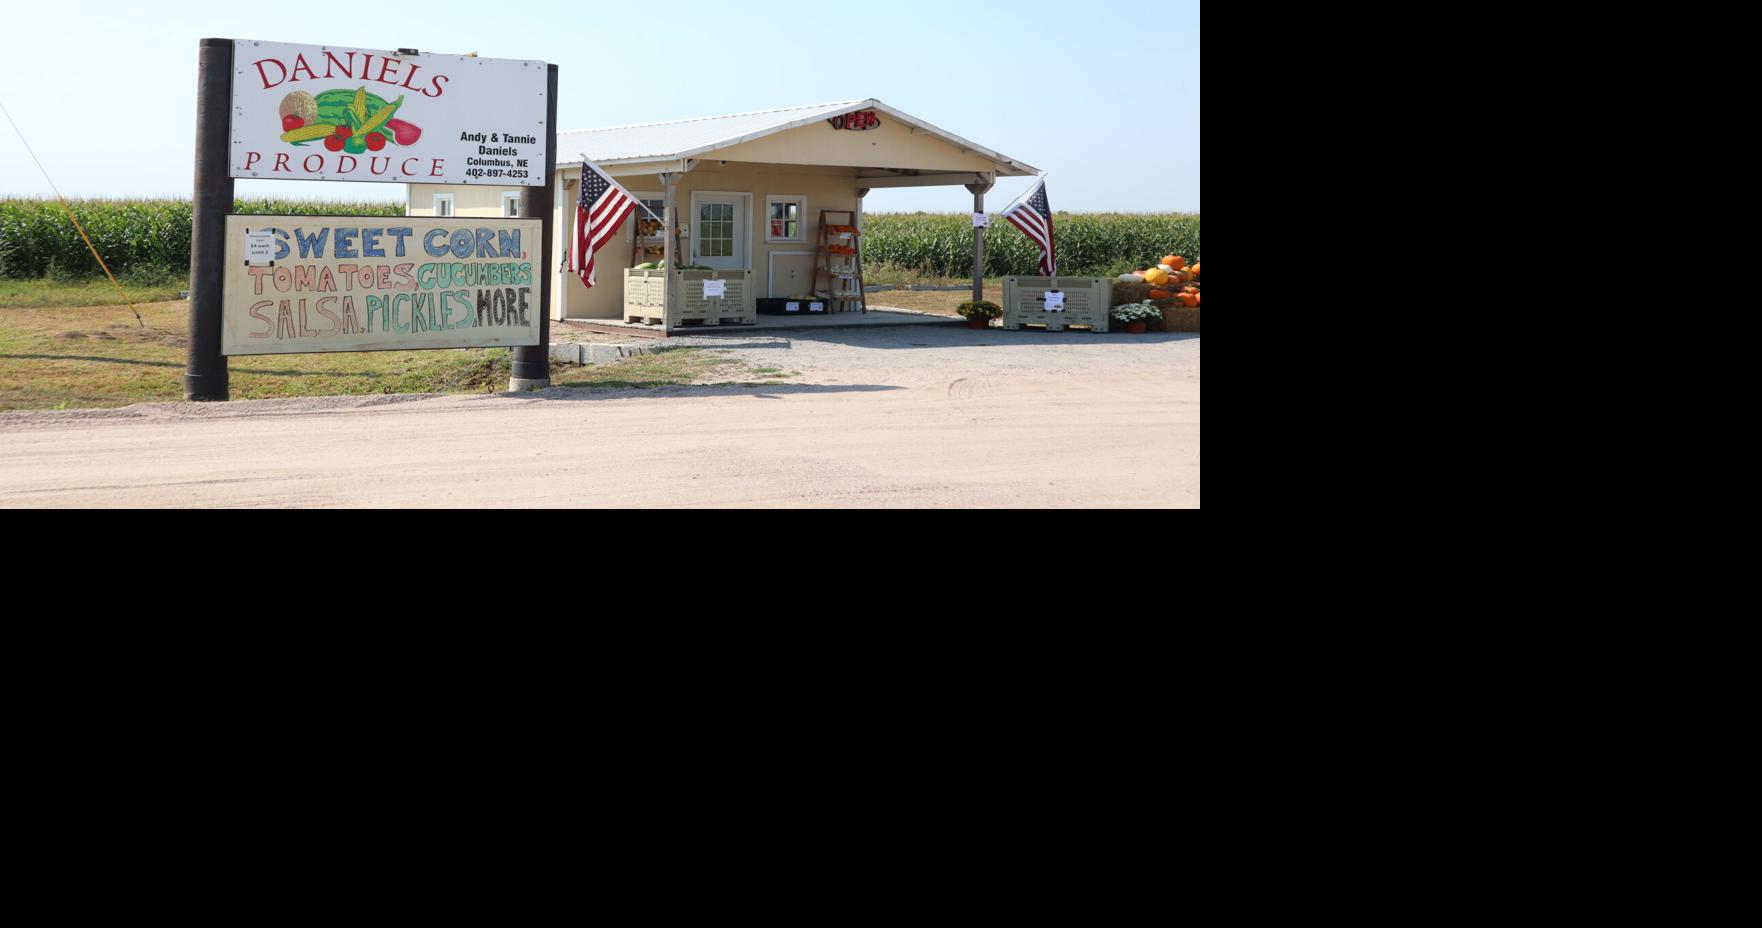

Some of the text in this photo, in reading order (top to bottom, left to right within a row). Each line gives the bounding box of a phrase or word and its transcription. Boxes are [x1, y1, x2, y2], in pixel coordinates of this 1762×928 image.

[252, 50, 449, 99] DANIELS
[832, 110, 876, 130] OPEN
[460, 131, 537, 144] Andy & Tannie
[478, 145, 518, 156] Daniels
[243, 151, 445, 178] PRODUCE
[465, 168, 529, 178] 402-897-4253
[466, 157, 529, 168] Columbus, NE
[259, 227, 527, 260] SWEET CORN,
[248, 261, 532, 295] TOMATOES, CUCUMBERS
[366, 289, 477, 335] PICKLES,
[476, 287, 531, 328] MORE
